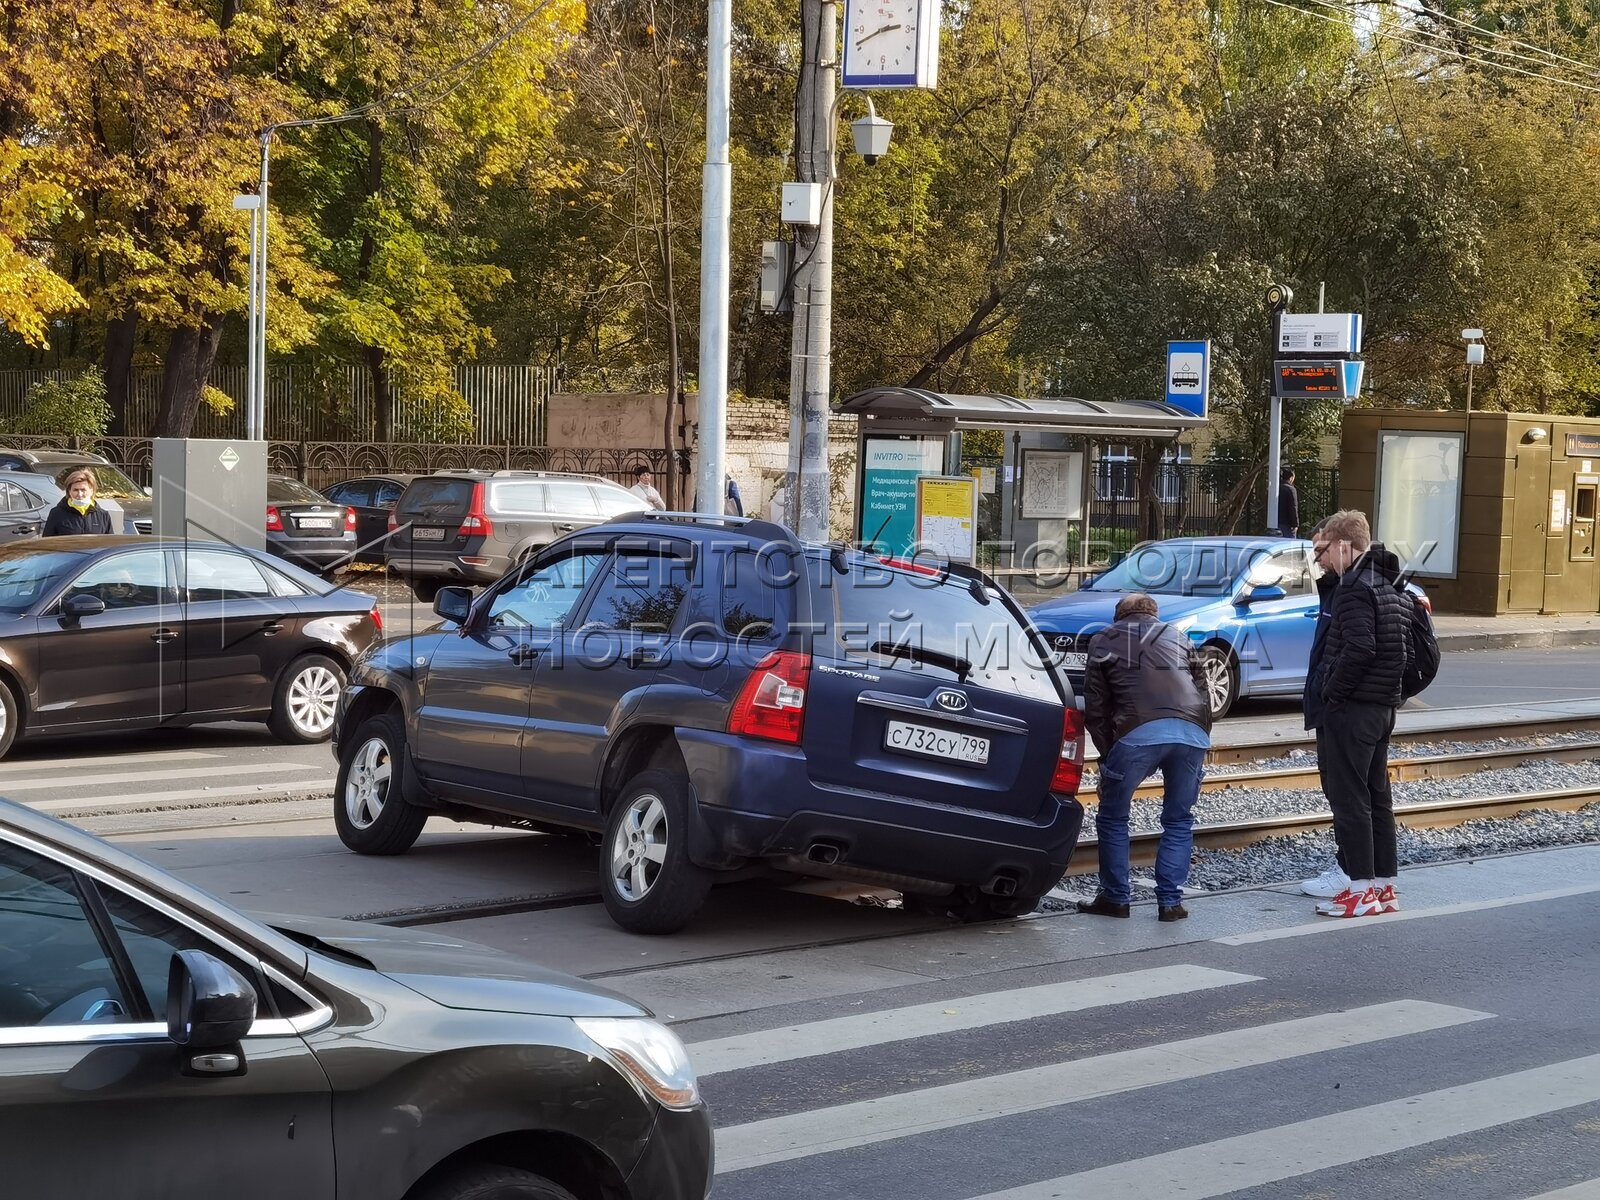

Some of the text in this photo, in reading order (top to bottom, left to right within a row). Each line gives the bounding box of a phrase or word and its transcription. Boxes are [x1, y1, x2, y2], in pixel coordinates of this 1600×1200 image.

[873, 452, 904, 461] INVITRO
[870, 502, 907, 511] Кабинет УЗИ
[940, 693, 963, 708] KIA
[892, 726, 986, 756] С732СУ 799
[965, 753, 978, 762] RUS
